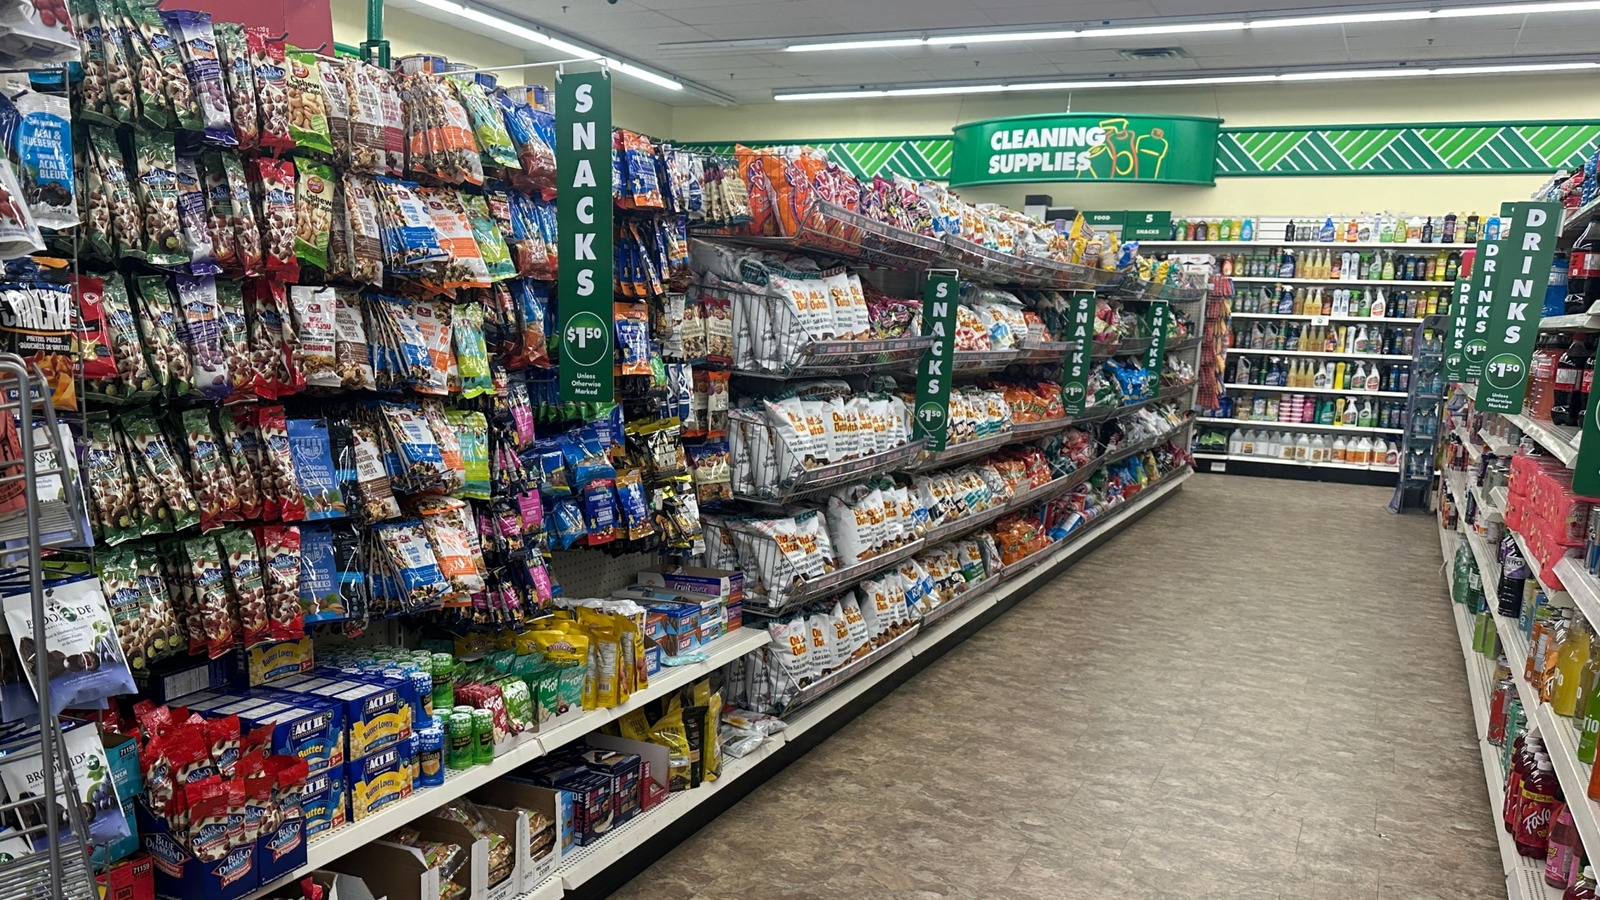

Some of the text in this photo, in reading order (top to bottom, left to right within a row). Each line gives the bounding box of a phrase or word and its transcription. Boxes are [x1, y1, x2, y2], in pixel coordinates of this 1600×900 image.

[991, 126, 1106, 150] CLEANING
[988, 152, 1091, 174] SUPPLIES
[572, 84, 597, 296] SNACKS
[1145, 214, 1154, 223] 5
[1504, 208, 1547, 344] DRINKS
[1475, 244, 1499, 333] DRINKS
[1454, 283, 1471, 349] DRINKS
[927, 282, 948, 395] SNACKS
[1072, 298, 1088, 377] SNACKS
[1148, 307, 1162, 367] SNACKS
[304, 344, 333, 352] CASHEWS
[809, 425, 825, 436] utch
[775, 534, 788, 543] Old
[268, 557, 299, 569] DIAMOND
[274, 555, 290, 564] BLUE
[110, 592, 140, 606] DIAMOND
[115, 589, 131, 599] BLUE
[847, 612, 862, 625] Dutch
[262, 650, 294, 667] Butter Lovers
[368, 692, 396, 710] ACT II
[295, 716, 324, 735] ACT II
[362, 720, 393, 739] Butter Lovers
[120, 746, 136, 756] 71159
[298, 744, 323, 758] Butter
[369, 756, 386, 770] ACT
[386, 751, 396, 763] II
[301, 776, 326, 796] CT II
[365, 779, 395, 799] Butter Lovers
[305, 806, 326, 819] utter
[193, 826, 227, 845] DIAMOND
[199, 824, 216, 836] BLUE
[271, 823, 301, 849] DIAMOND
[277, 824, 293, 837] BLUE
[145, 837, 185, 863] DIAMOND
[155, 834, 175, 851] BLUE
[219, 849, 251, 874] DIAMOND
[227, 851, 244, 864] BLUE
[132, 863, 150, 875] 71159
[539, 865, 551, 877] CORN
